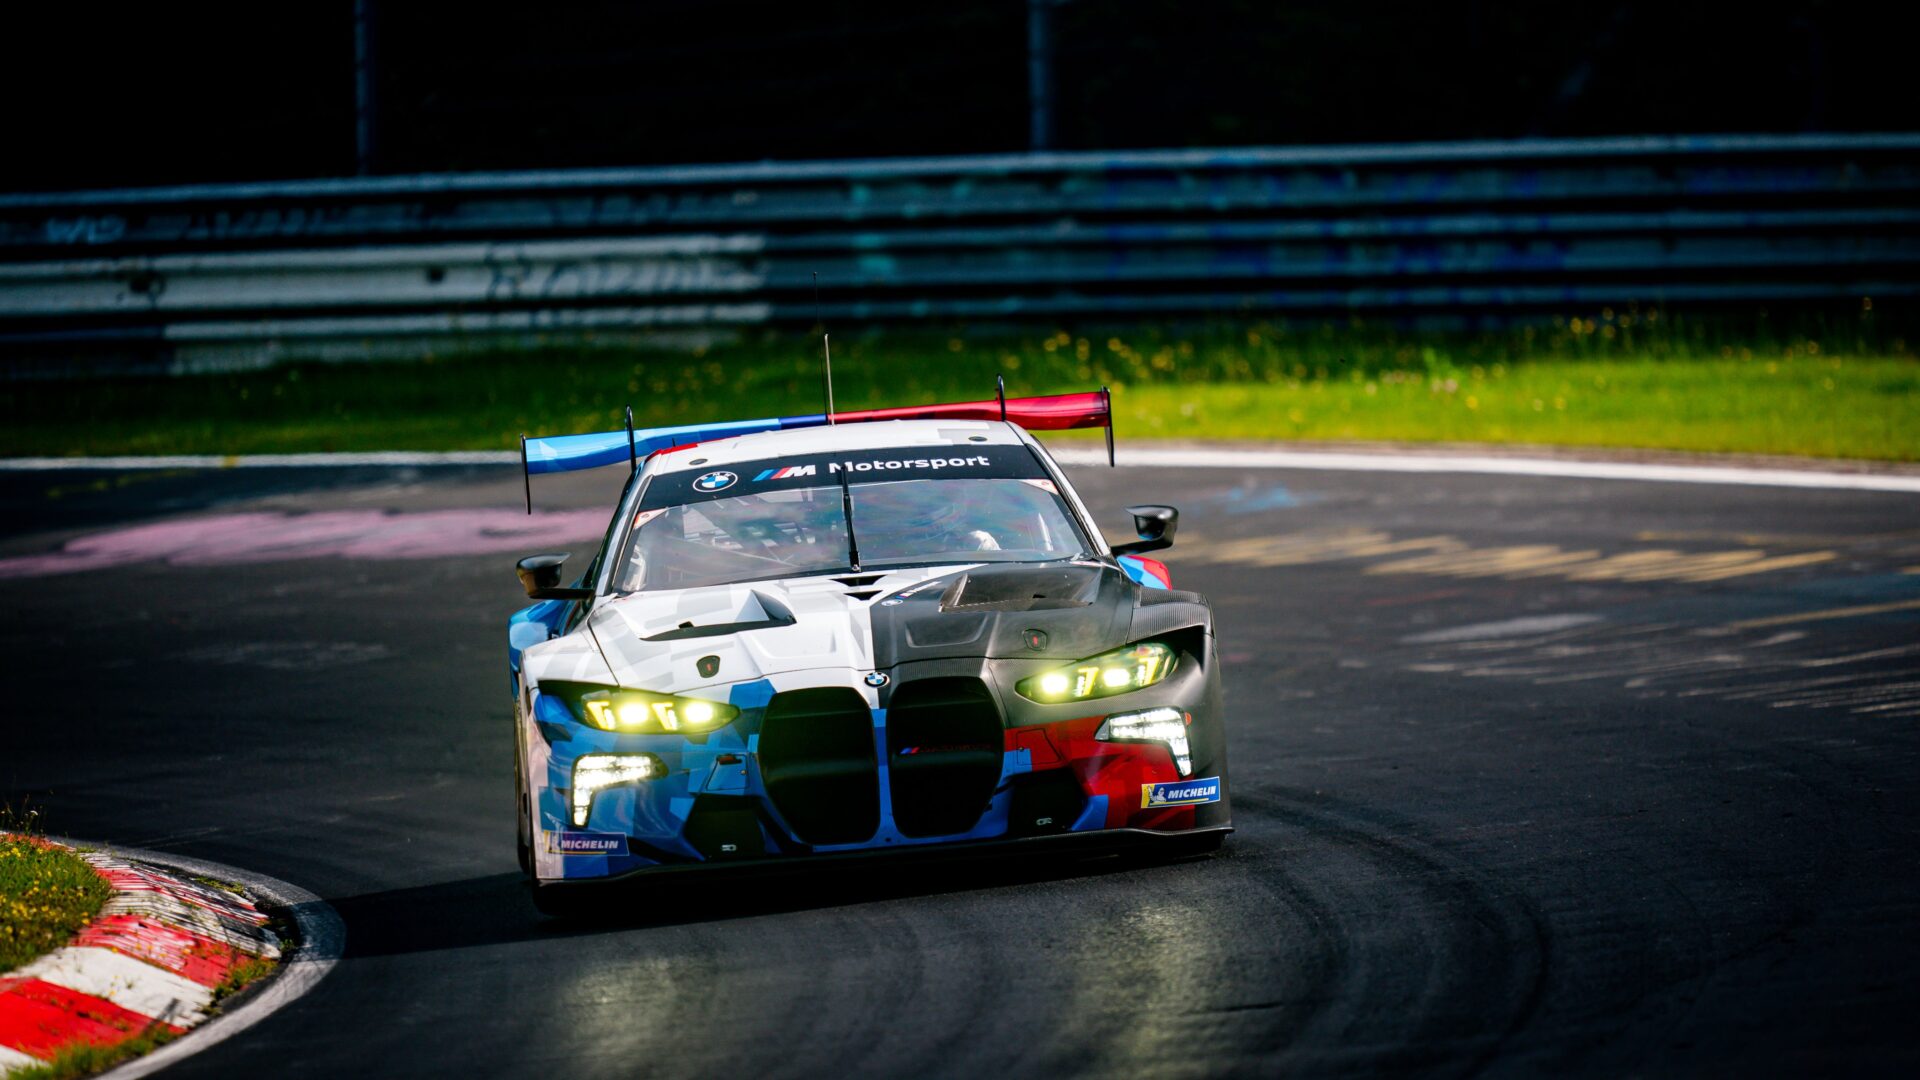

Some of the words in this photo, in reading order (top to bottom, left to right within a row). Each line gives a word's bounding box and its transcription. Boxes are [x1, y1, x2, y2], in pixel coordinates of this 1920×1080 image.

[780, 465, 816, 479] M
[829, 456, 990, 474] Motorsport
[1167, 785, 1217, 799] MICHELIN
[561, 840, 619, 849] MICHELIN
